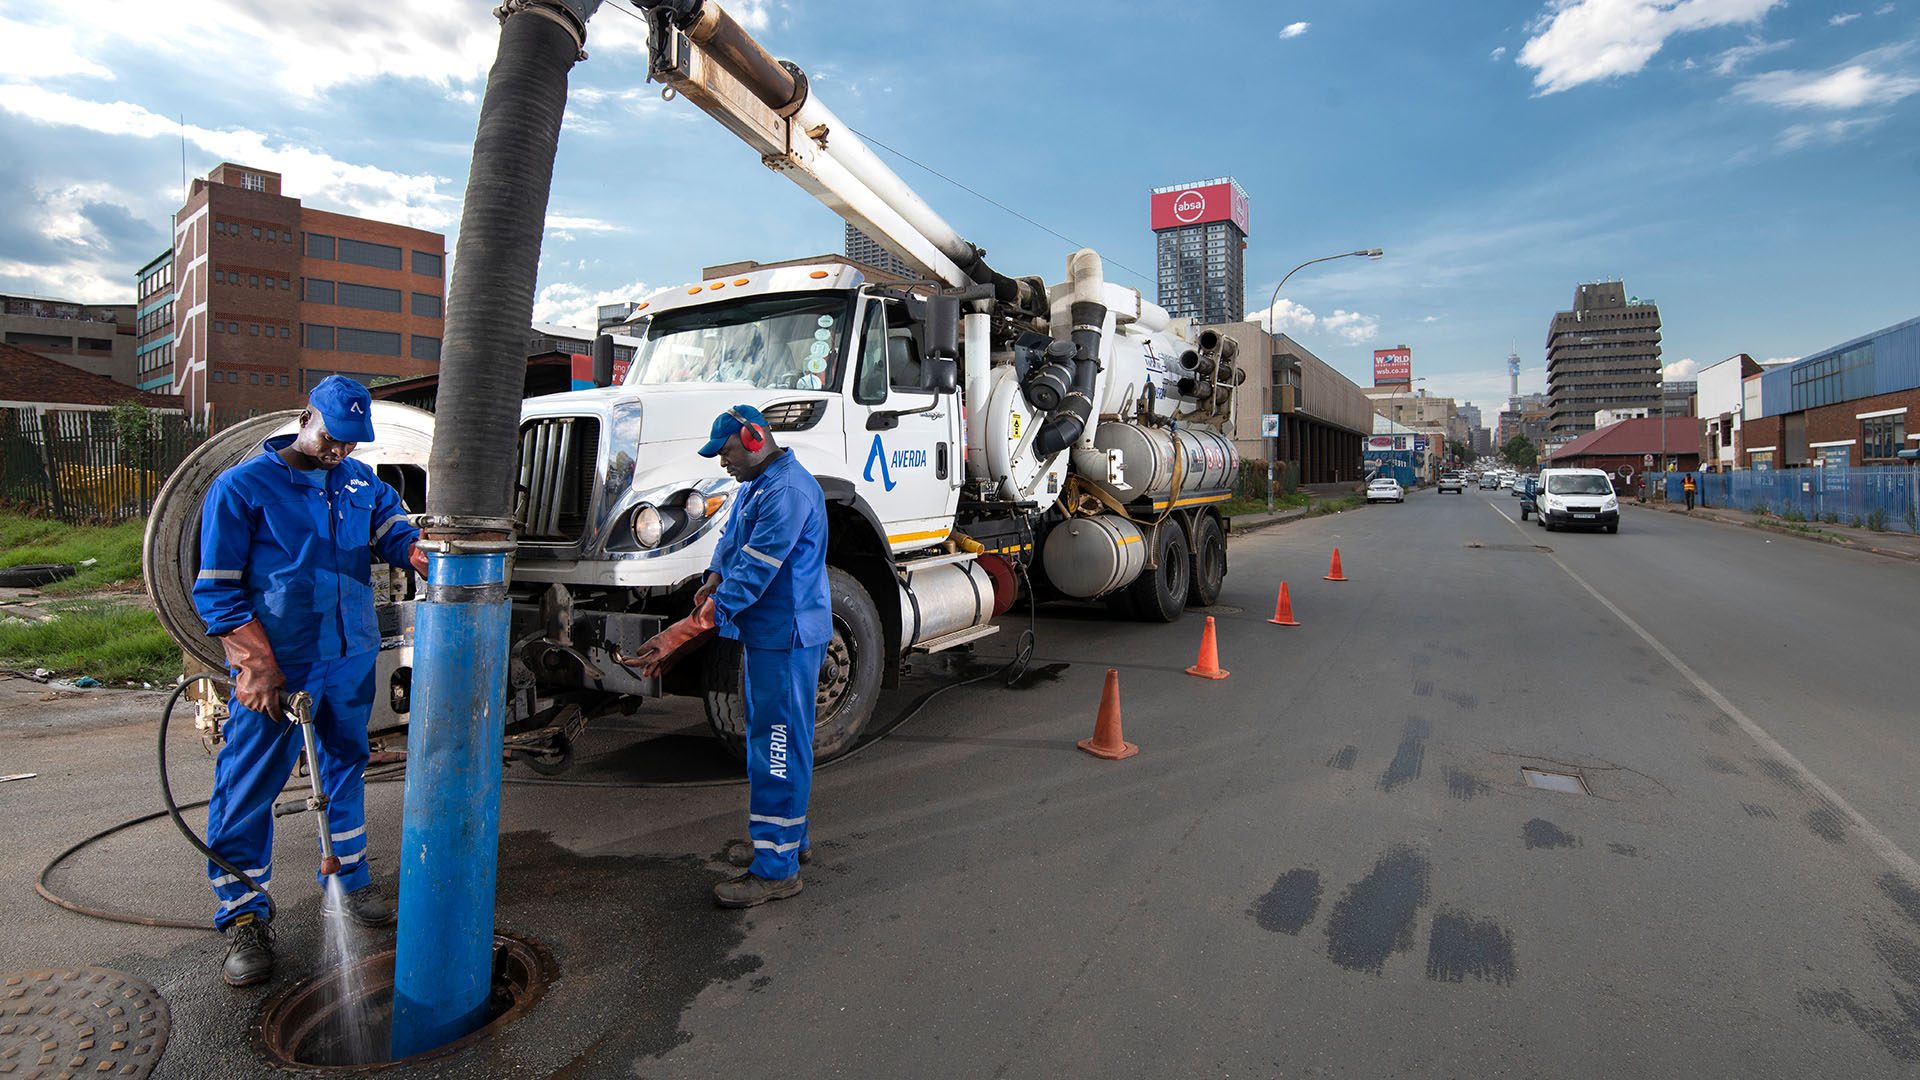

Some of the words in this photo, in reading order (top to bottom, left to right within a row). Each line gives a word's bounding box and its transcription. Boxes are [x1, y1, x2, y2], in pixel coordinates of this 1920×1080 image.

[1178, 201, 1201, 212] absa
[1375, 354, 1409, 364] WORLD
[891, 449, 927, 468] AVERDA
[770, 724, 787, 779] AVERDA
